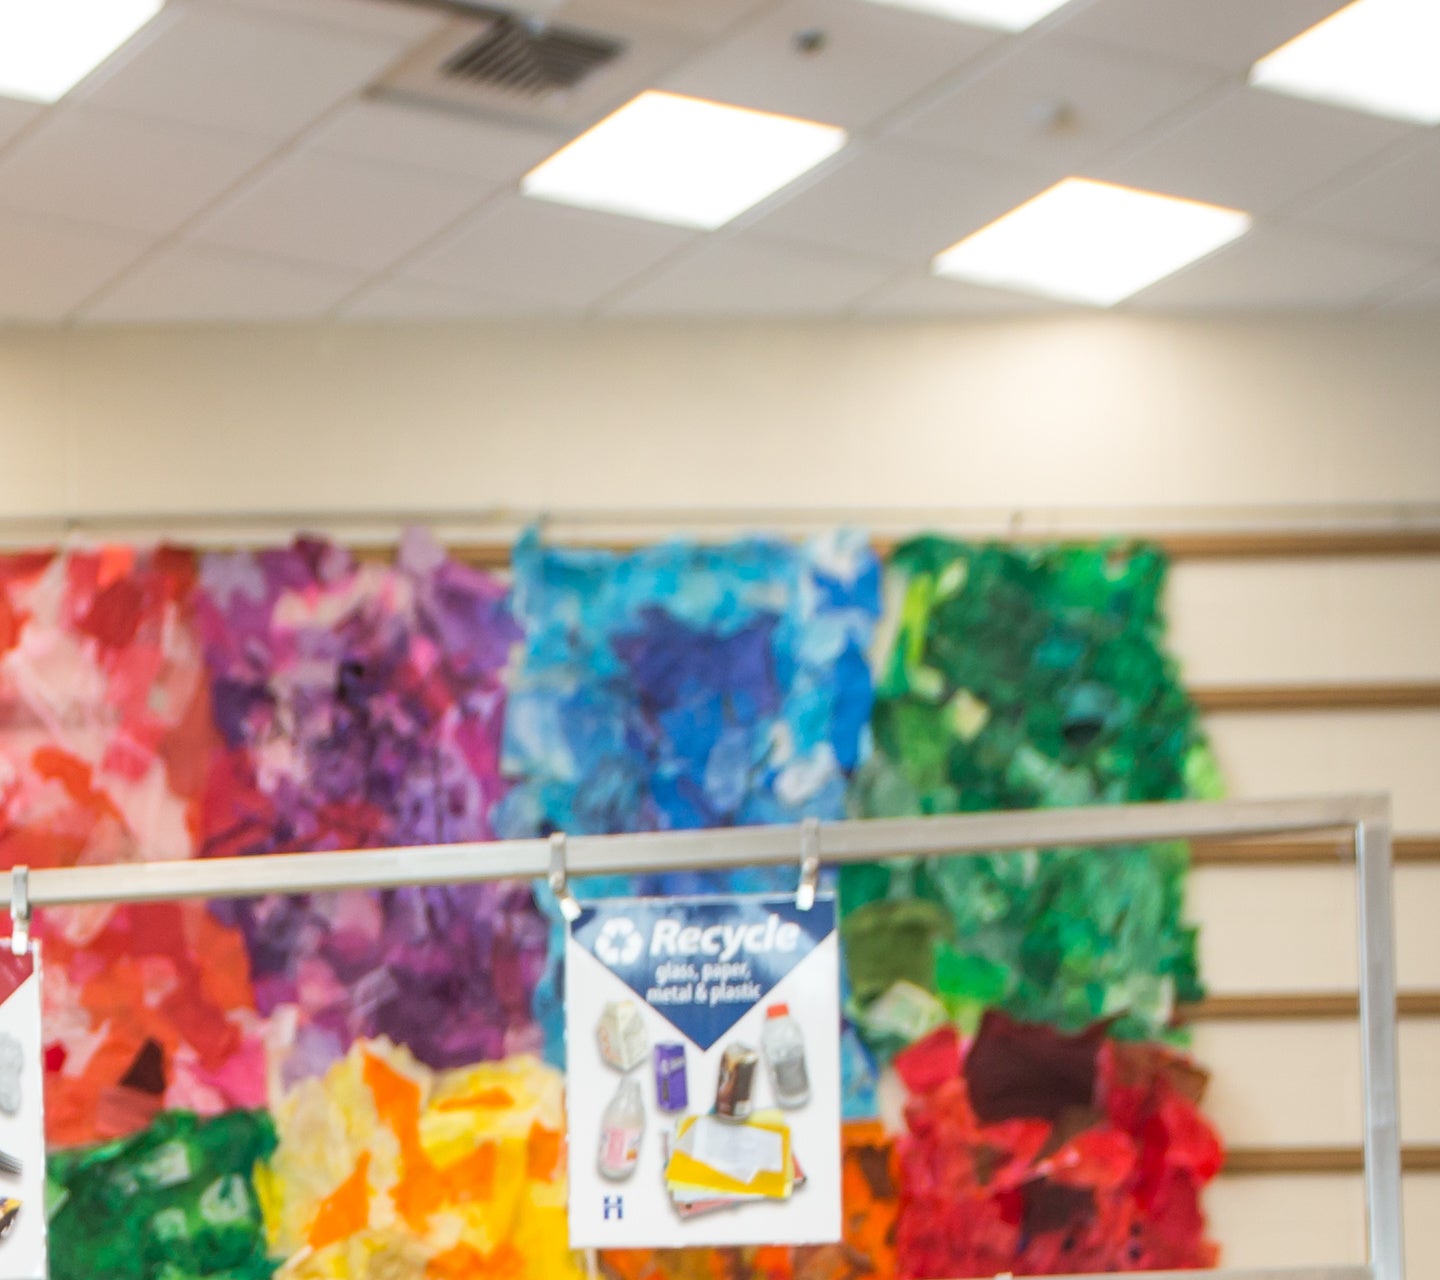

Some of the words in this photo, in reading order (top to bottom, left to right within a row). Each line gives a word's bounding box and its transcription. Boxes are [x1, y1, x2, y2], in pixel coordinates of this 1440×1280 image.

[649, 914, 801, 962] Recycle
[656, 961, 699, 986] glass,
[646, 983, 693, 1003] metal
[695, 983, 708, 1004] &
[709, 982, 761, 1007] plastic
